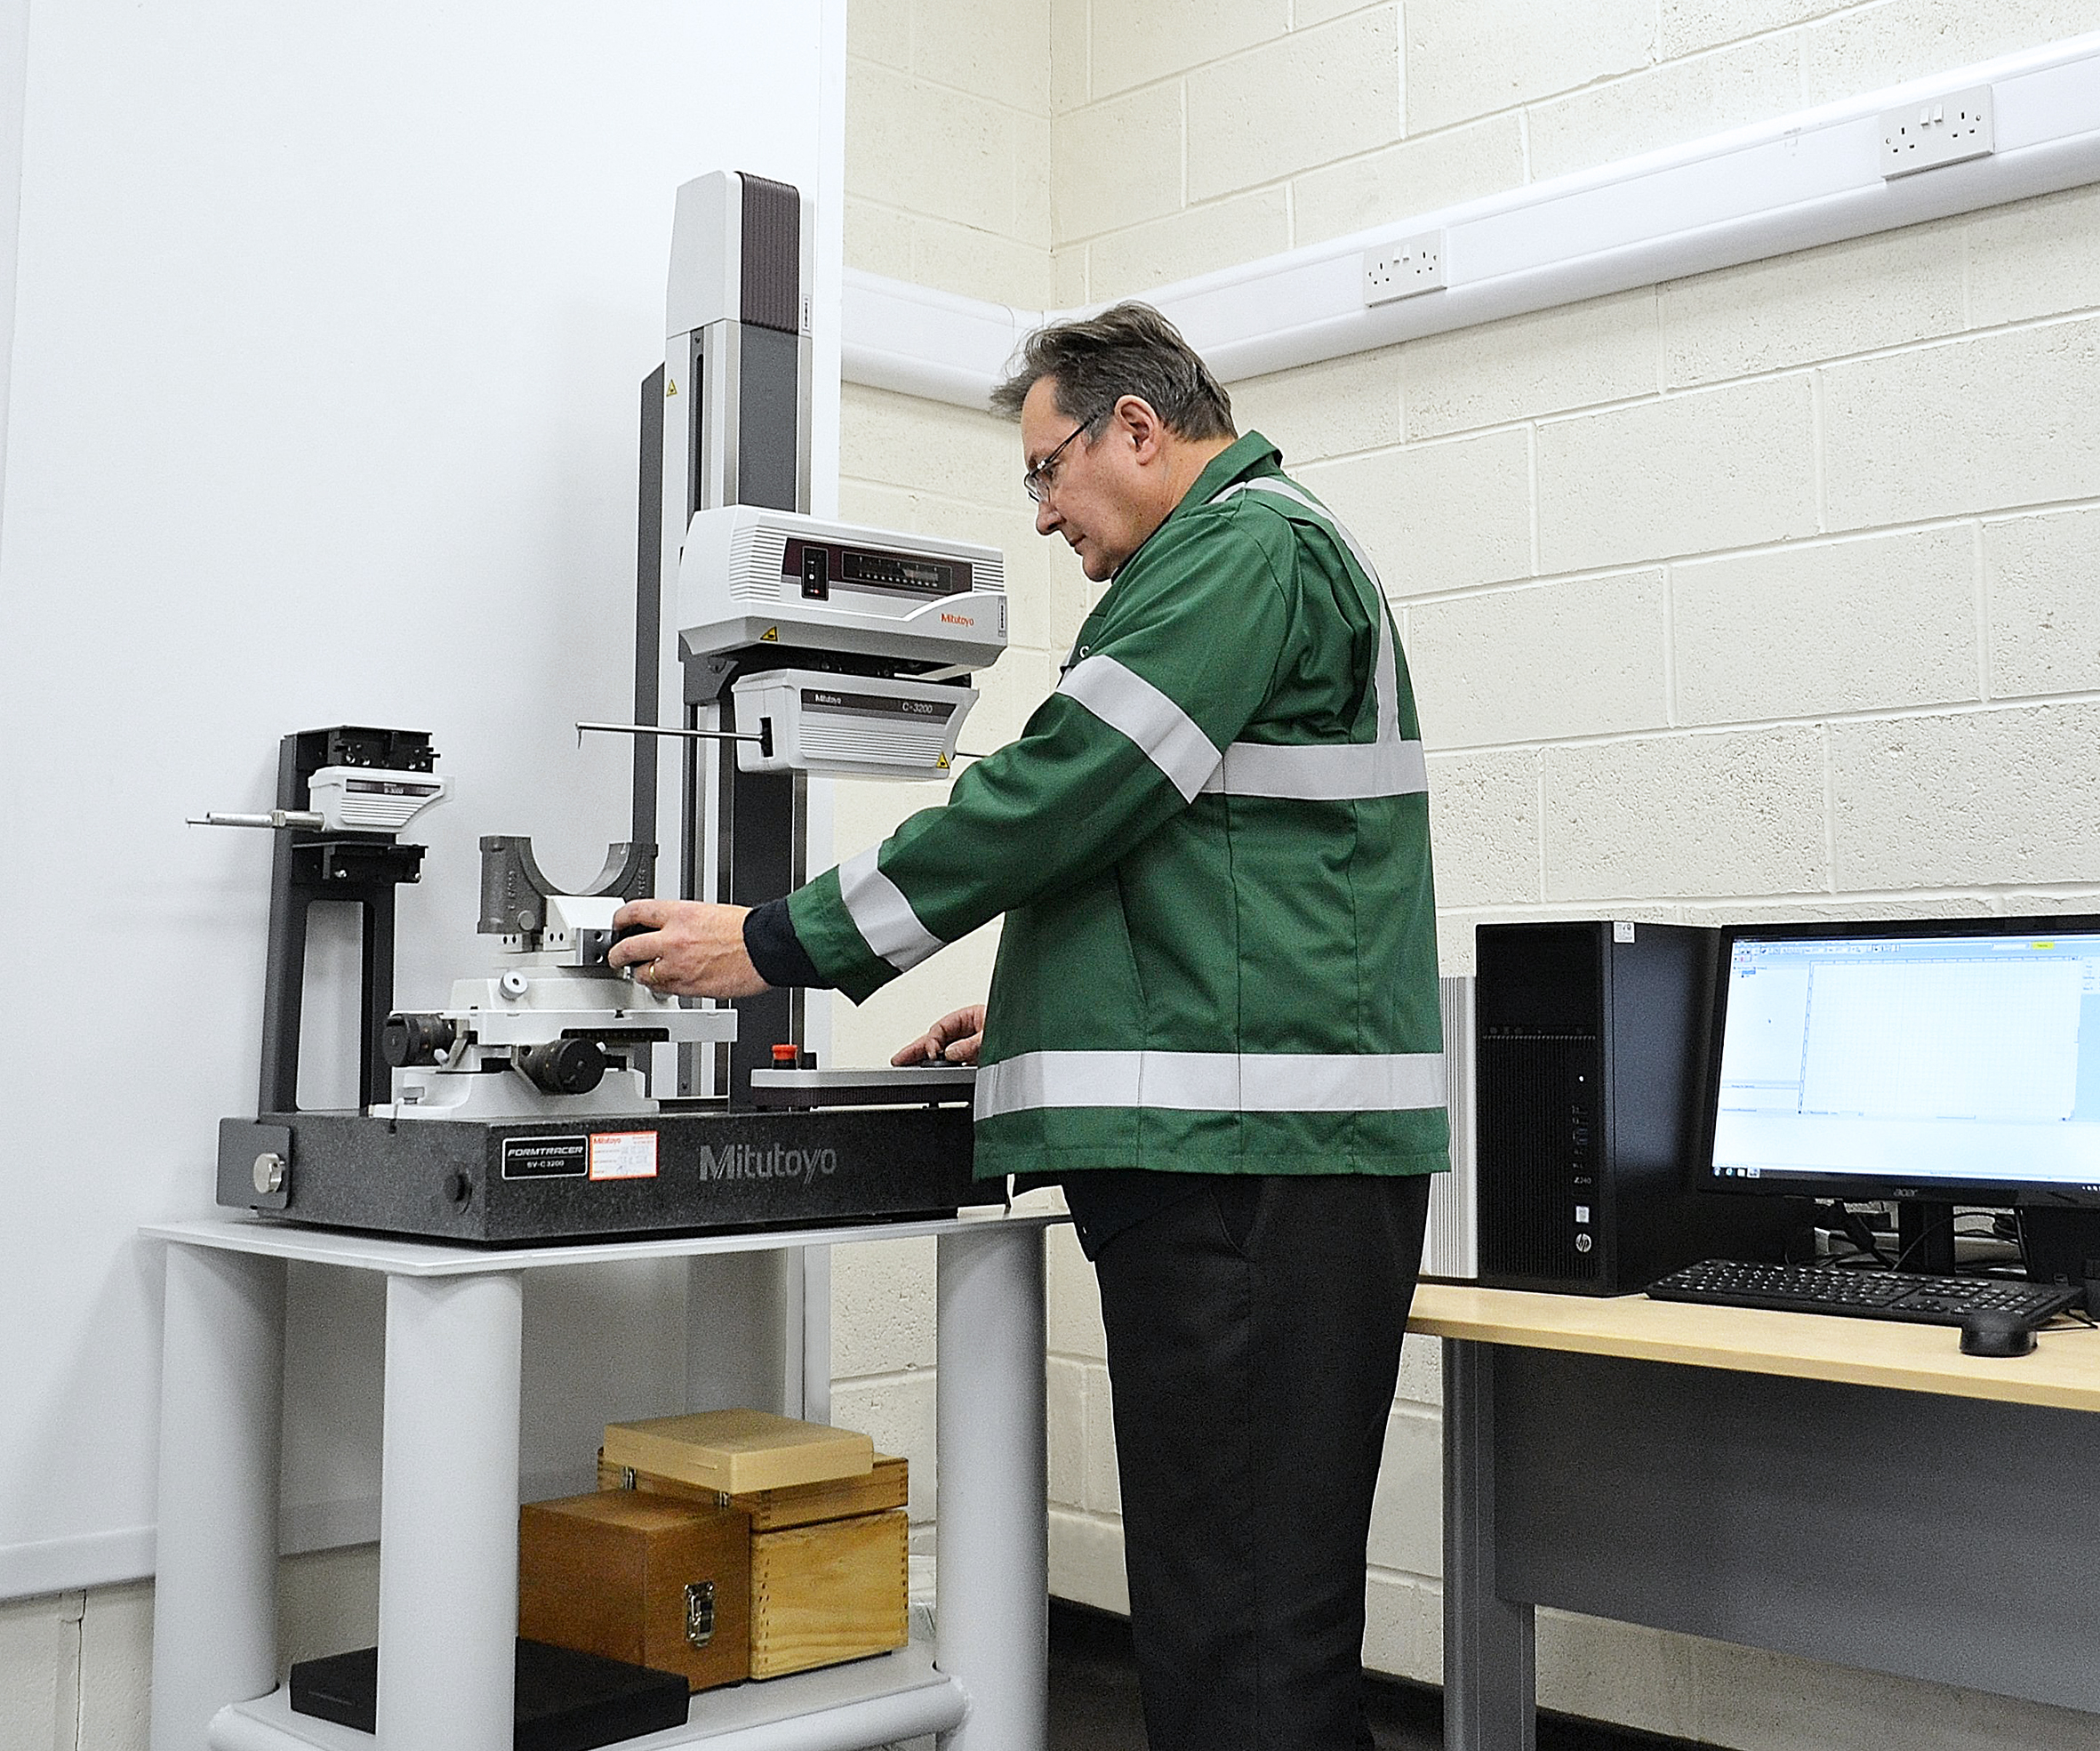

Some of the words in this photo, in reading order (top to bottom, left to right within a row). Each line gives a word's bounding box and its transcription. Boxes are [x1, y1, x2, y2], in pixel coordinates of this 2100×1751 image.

[941, 613, 974, 627] Mitutoyo
[902, 702, 934, 714] C-3200
[508, 1145, 584, 1157] FORMTRACER
[699, 1142, 838, 1186] Mitutoyo
[1893, 1188, 1919, 1198] acer
